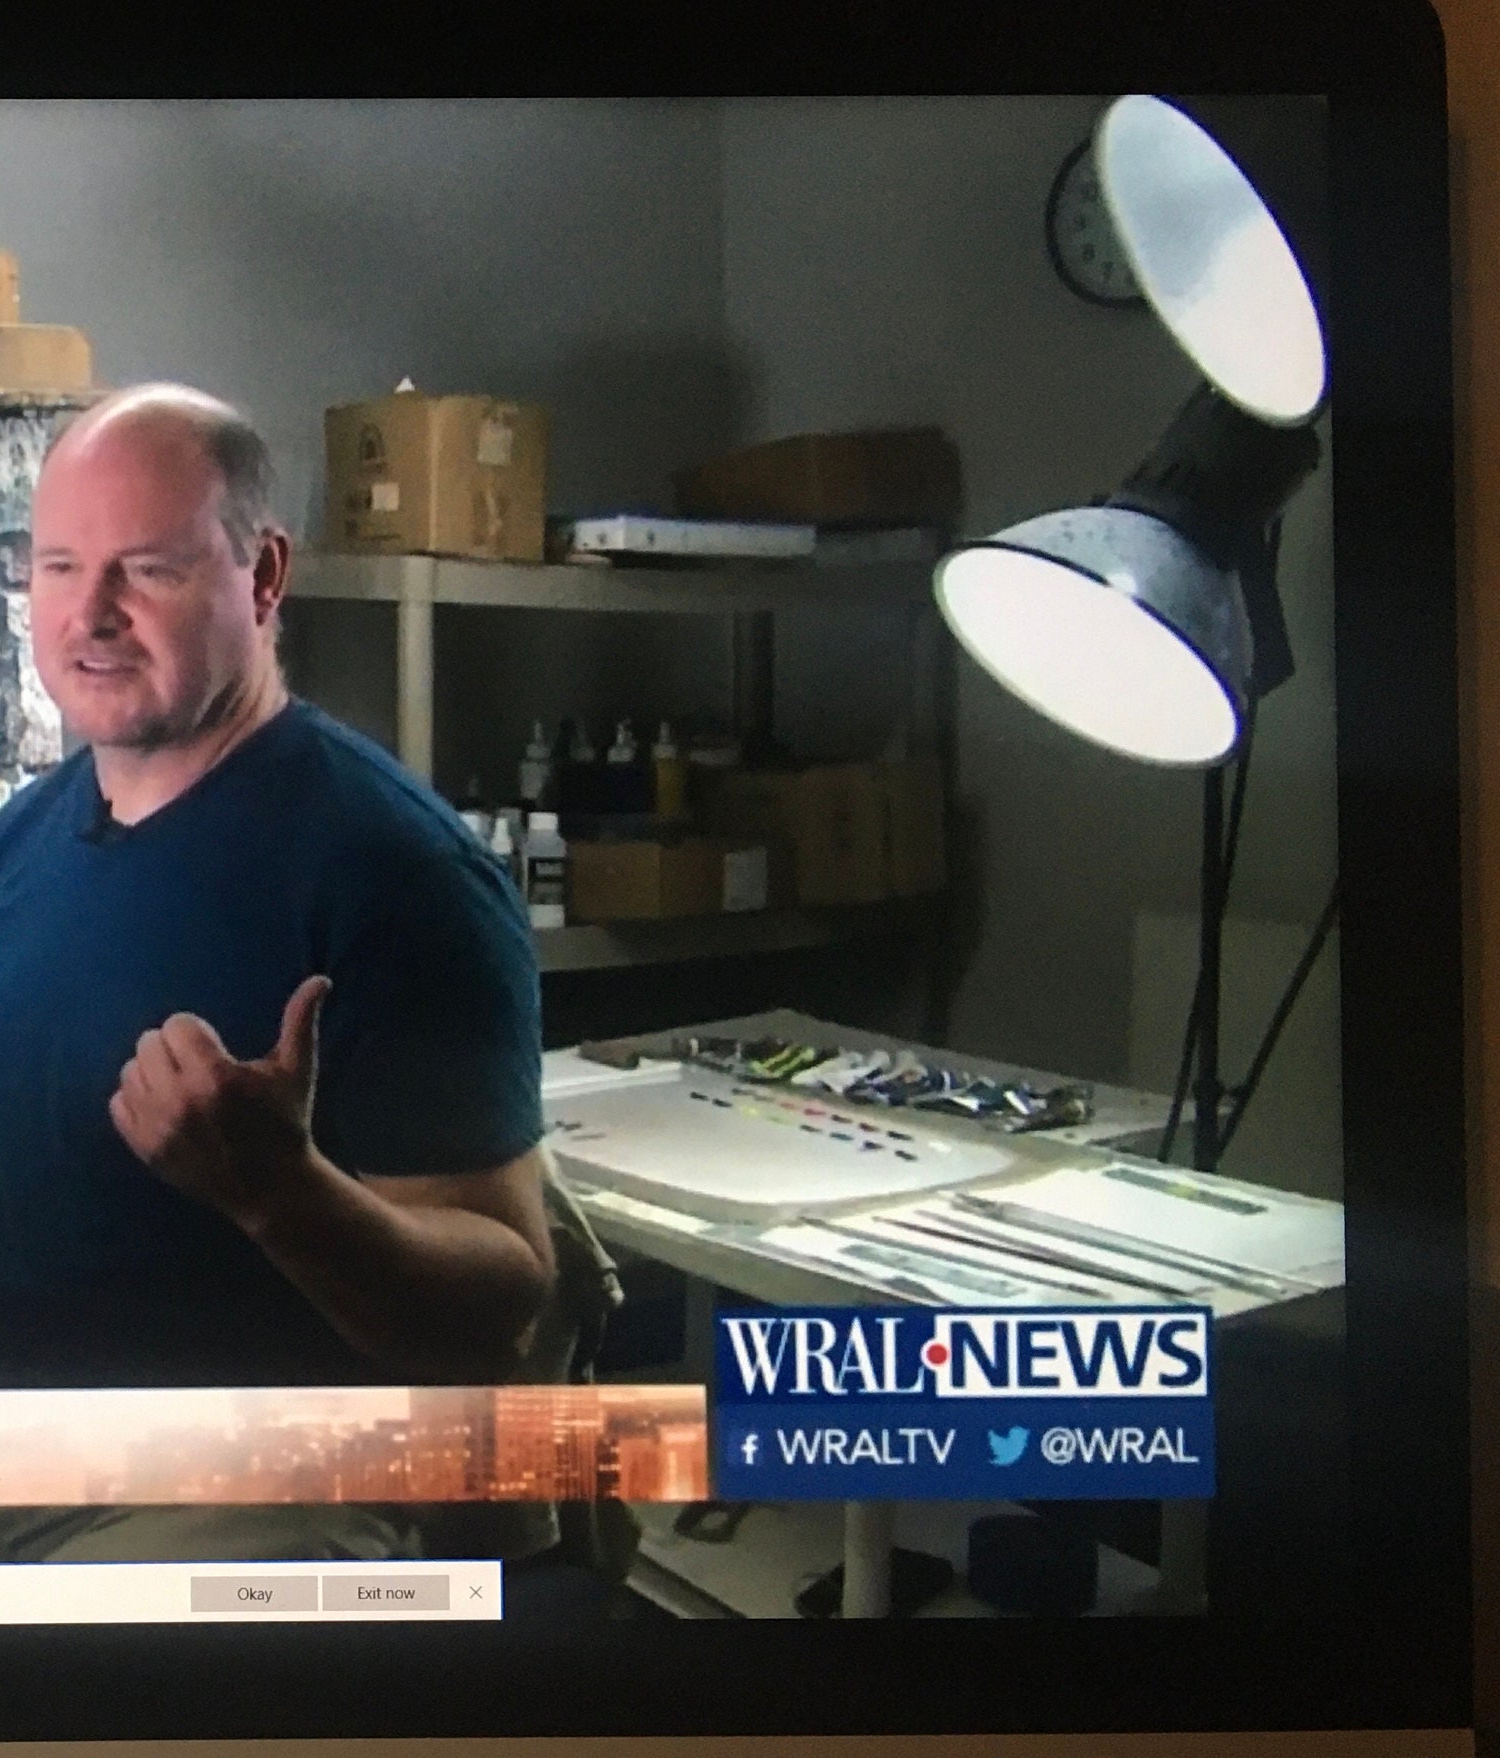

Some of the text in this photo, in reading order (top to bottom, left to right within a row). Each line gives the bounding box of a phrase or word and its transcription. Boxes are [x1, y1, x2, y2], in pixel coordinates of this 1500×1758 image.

[721, 1316, 1202, 1395] WRAL NEWS
[777, 1429, 956, 1465] WRALTV
[1040, 1427, 1199, 1466] @WRAL
[237, 1587, 273, 1603] Okay
[358, 1587, 416, 1600] Exit now
